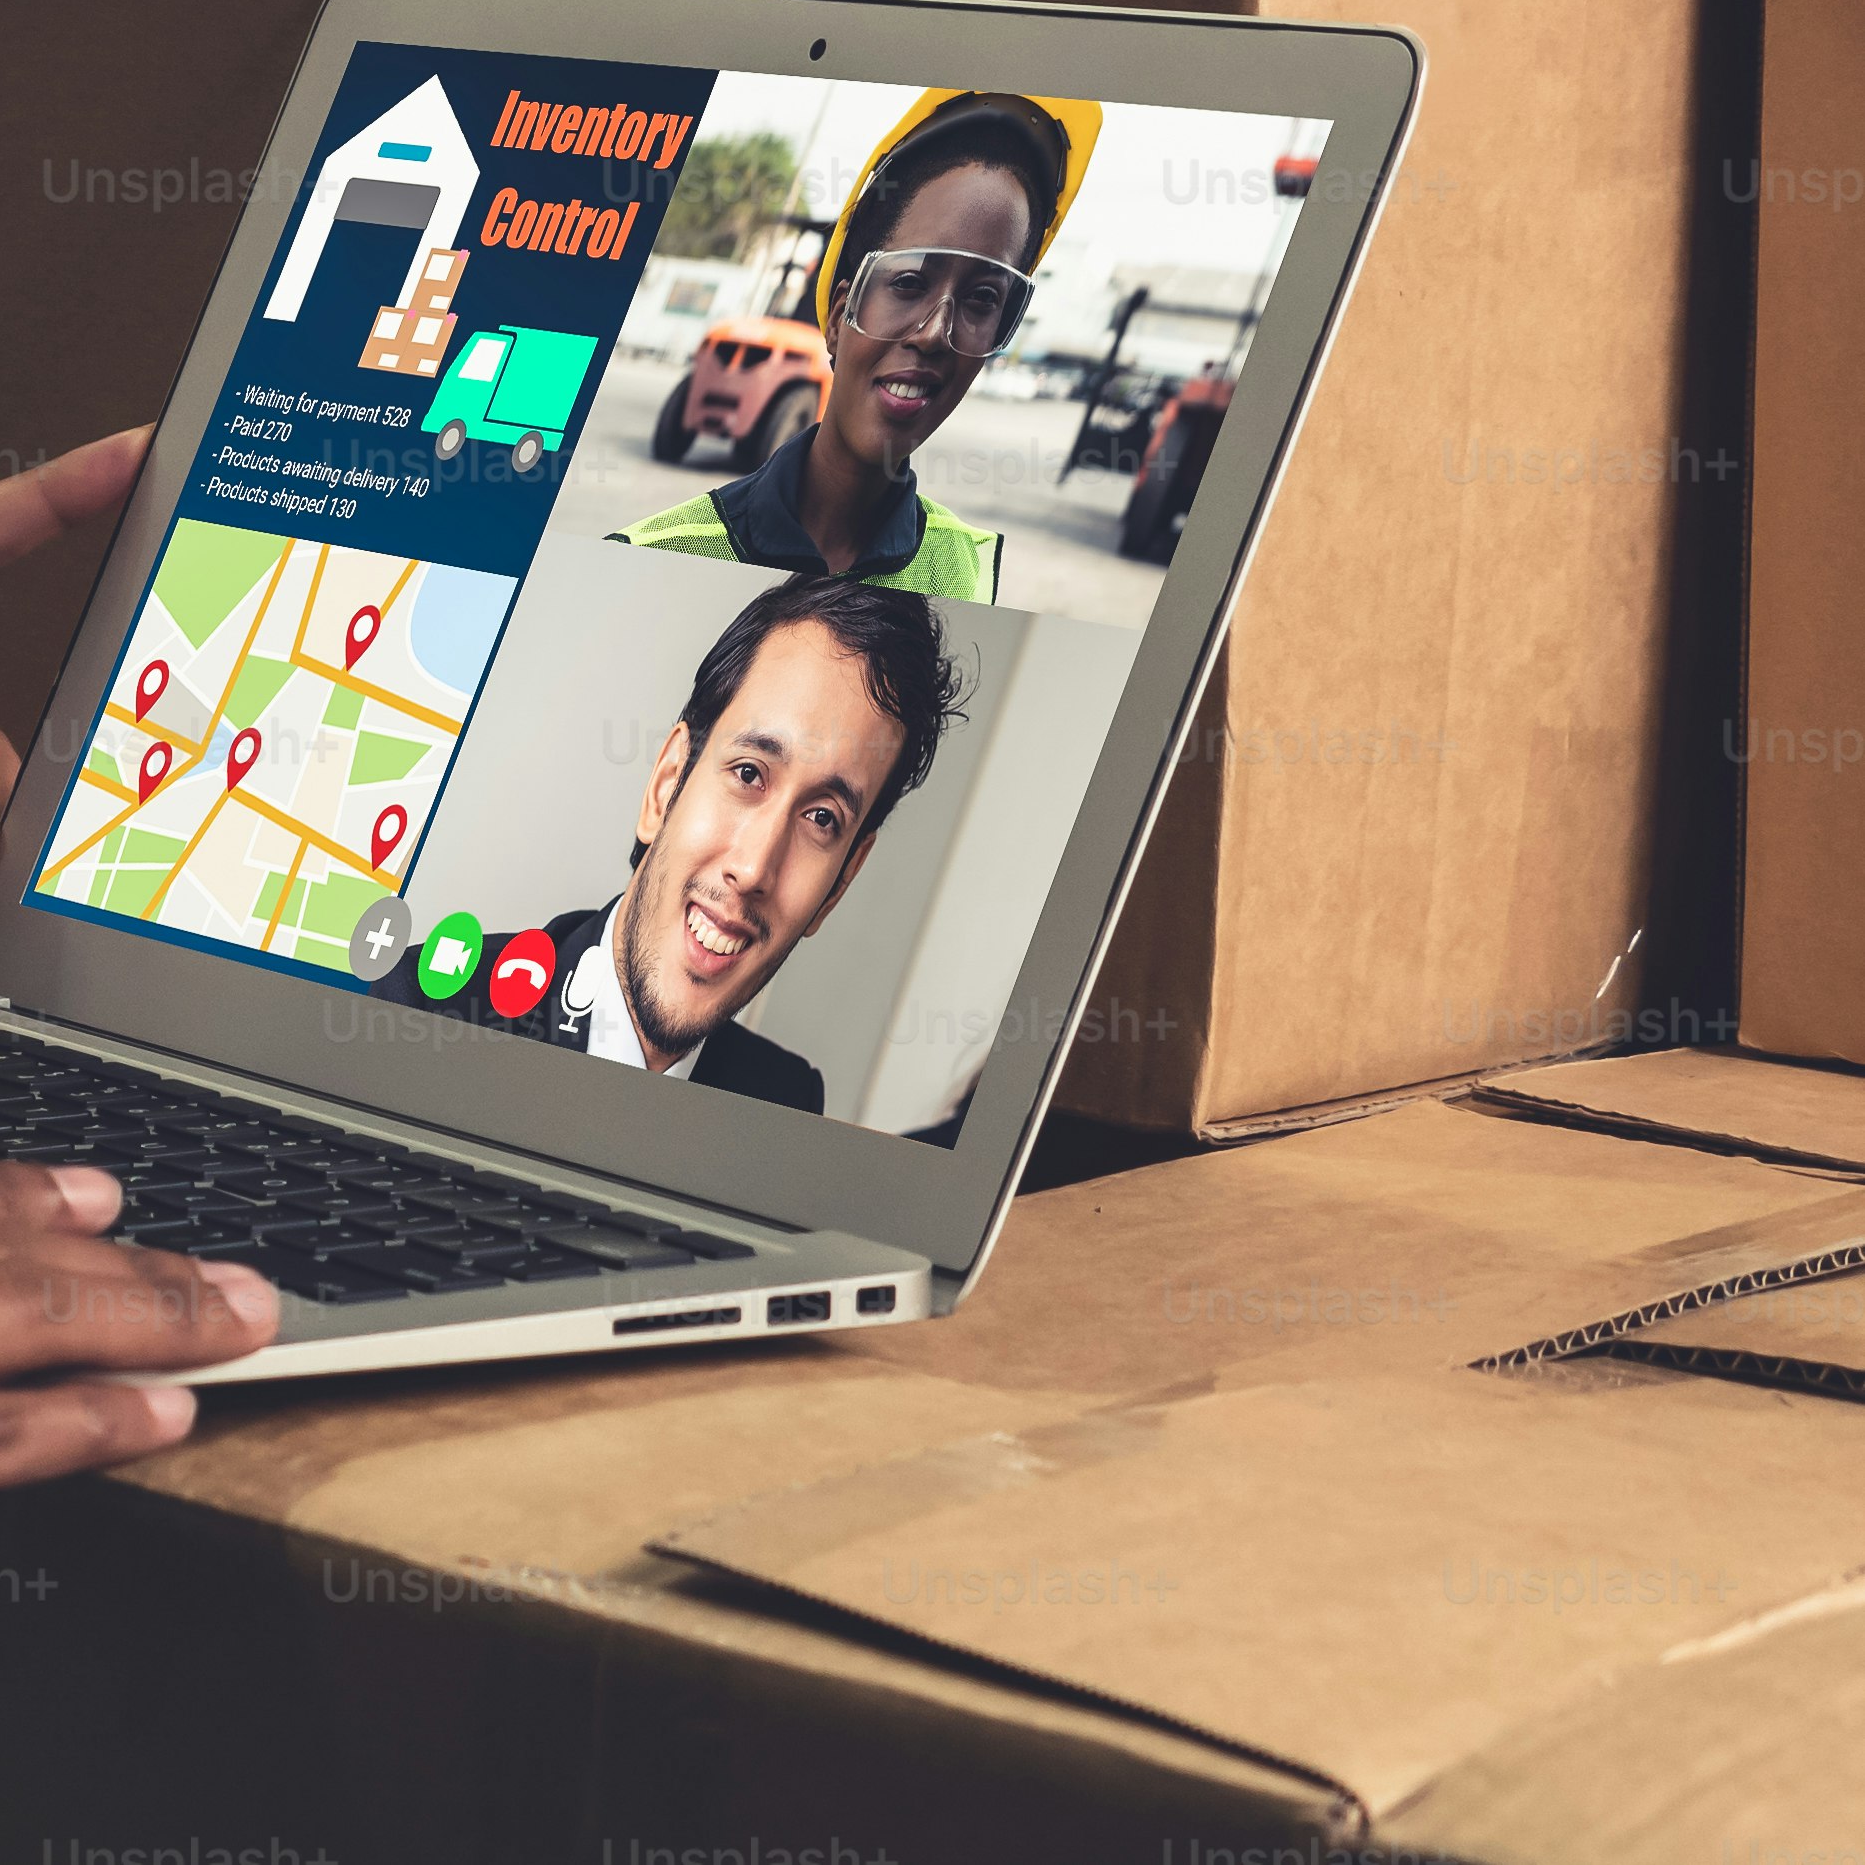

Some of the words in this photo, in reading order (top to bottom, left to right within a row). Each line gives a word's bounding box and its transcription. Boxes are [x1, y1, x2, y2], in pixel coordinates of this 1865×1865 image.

[490, 90, 693, 169] Inventory
[481, 187, 640, 260] Control
[230, 416, 263, 437] Paid
[263, 423, 292, 442] 270
[243, 384, 294, 414] Waiting
[296, 391, 318, 413] for
[317, 399, 380, 423] payment
[382, 406, 412, 428] 528
[219, 446, 280, 472] Products
[282, 460, 341, 488] awaiting
[344, 467, 399, 498] delivery
[403, 478, 429, 498] 140
[206, 476, 268, 504] Products
[270, 488, 328, 515] shipped
[330, 498, 356, 519] 130
